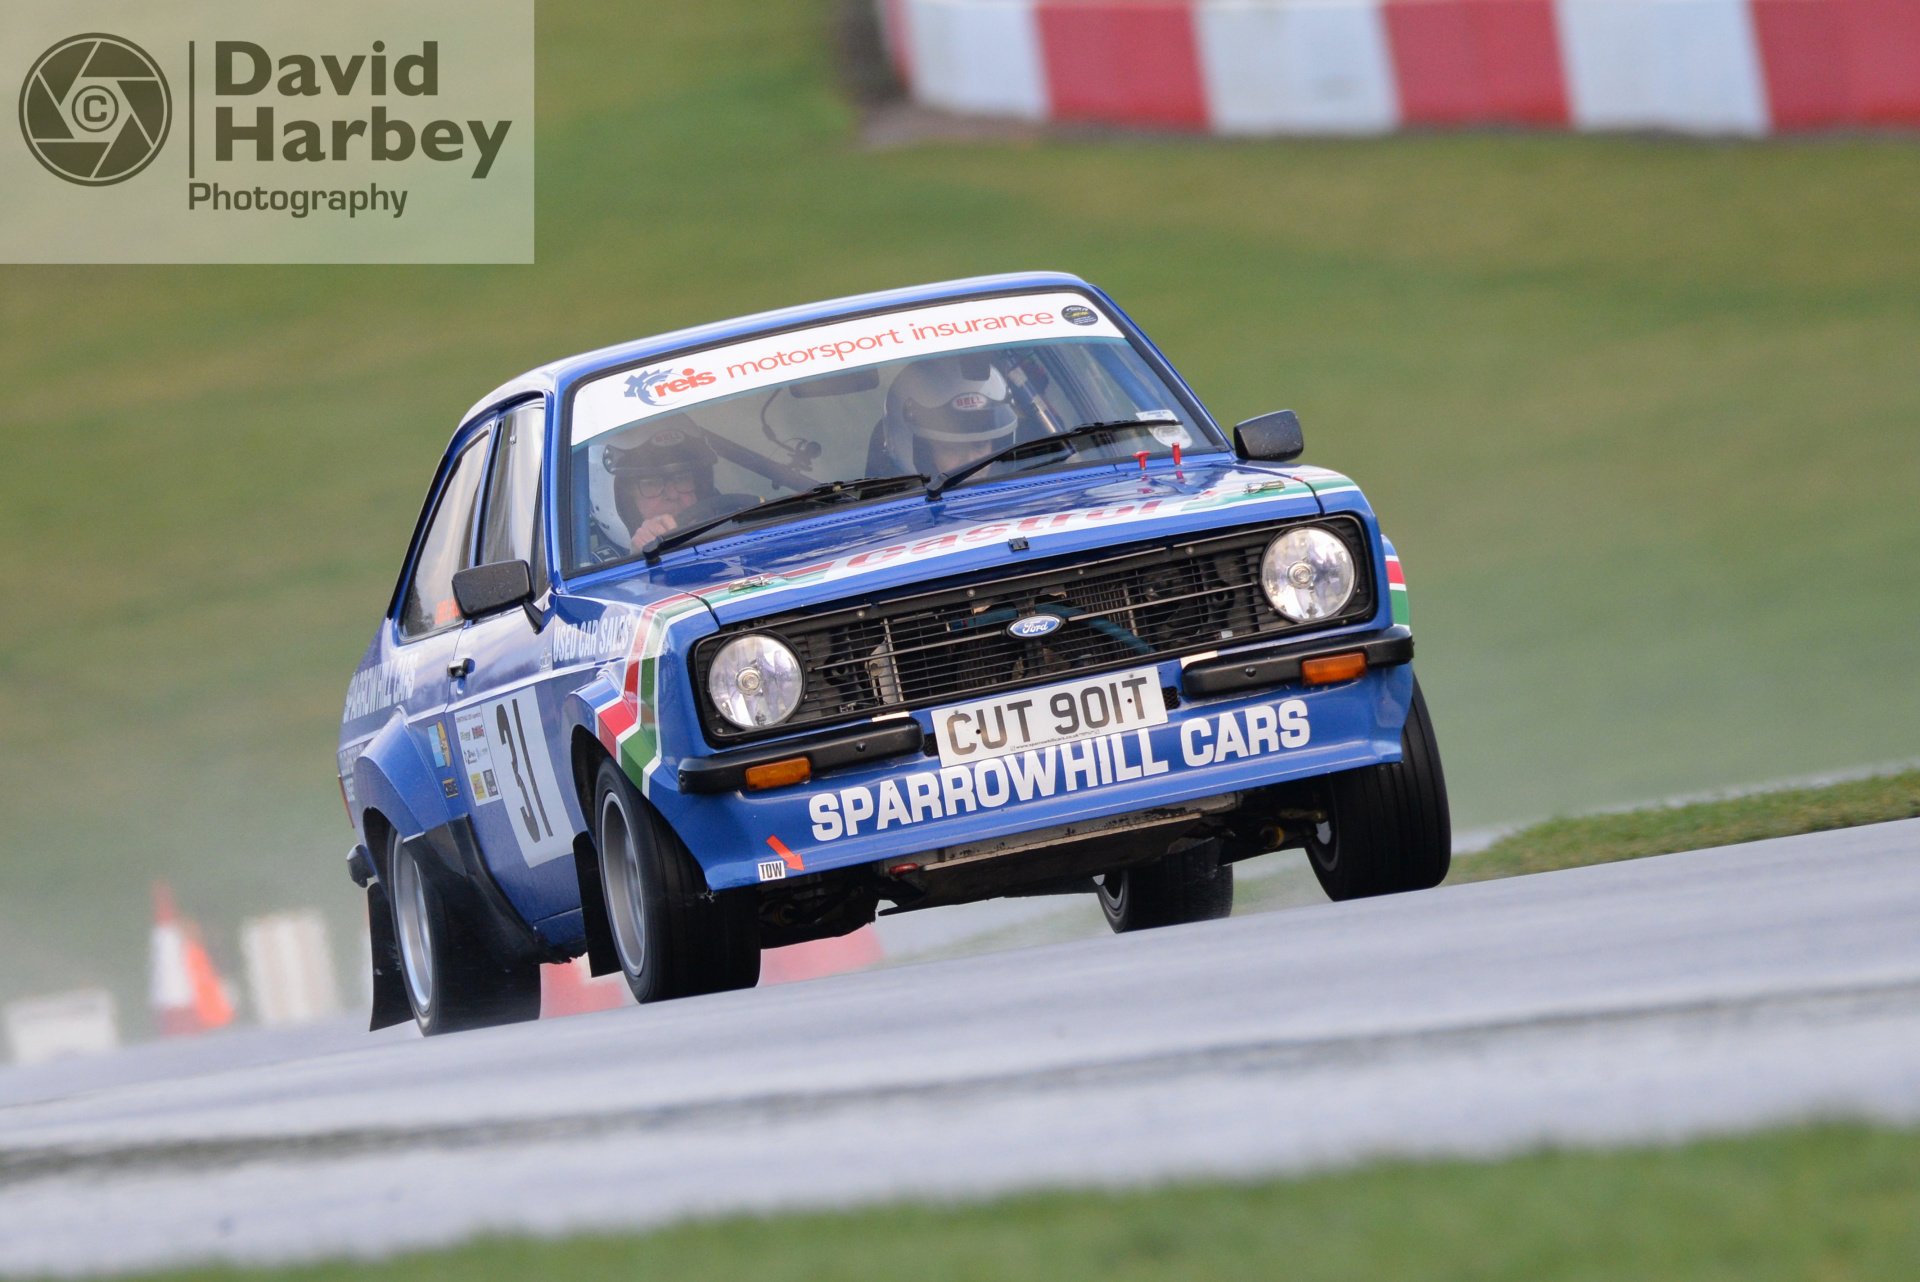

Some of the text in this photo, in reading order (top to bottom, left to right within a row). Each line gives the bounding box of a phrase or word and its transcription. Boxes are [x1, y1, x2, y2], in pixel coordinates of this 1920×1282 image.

[654, 311, 1055, 398] reis motorsport insurance
[847, 499, 1162, 568] Castrol
[552, 614, 633, 663] USED CAR SALES
[1022, 621, 1049, 634] Ford
[946, 676, 1148, 756] CUT 901T
[496, 698, 554, 844] 31
[808, 700, 1311, 842] SPARROWHILL CARS
[760, 862, 783, 880] TOW
